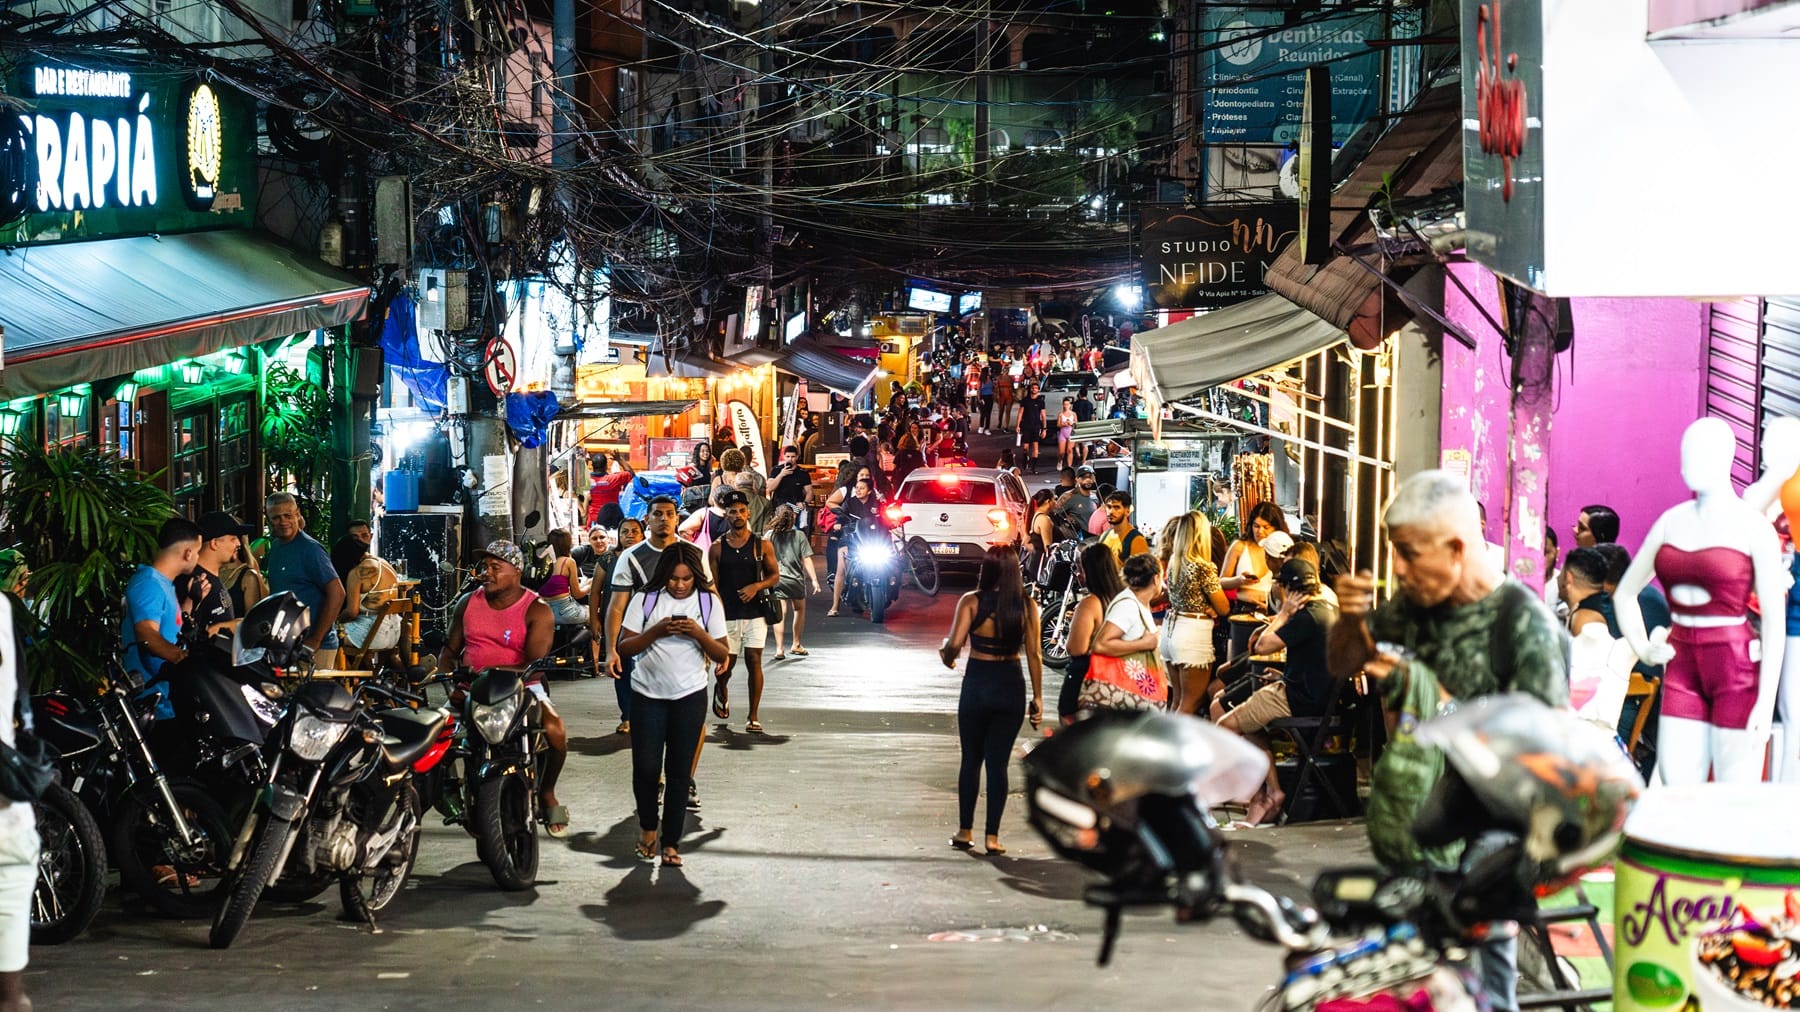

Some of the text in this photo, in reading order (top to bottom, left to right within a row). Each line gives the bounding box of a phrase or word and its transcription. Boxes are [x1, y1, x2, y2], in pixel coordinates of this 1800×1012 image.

[1268, 24, 1364, 44] Dentistas
[1212, 113, 1248, 121] Próteses
[20, 91, 157, 211] RAPIÁ
[1161, 240, 1231, 253] STUDIO
[1160, 261, 1246, 285] NEIDE
